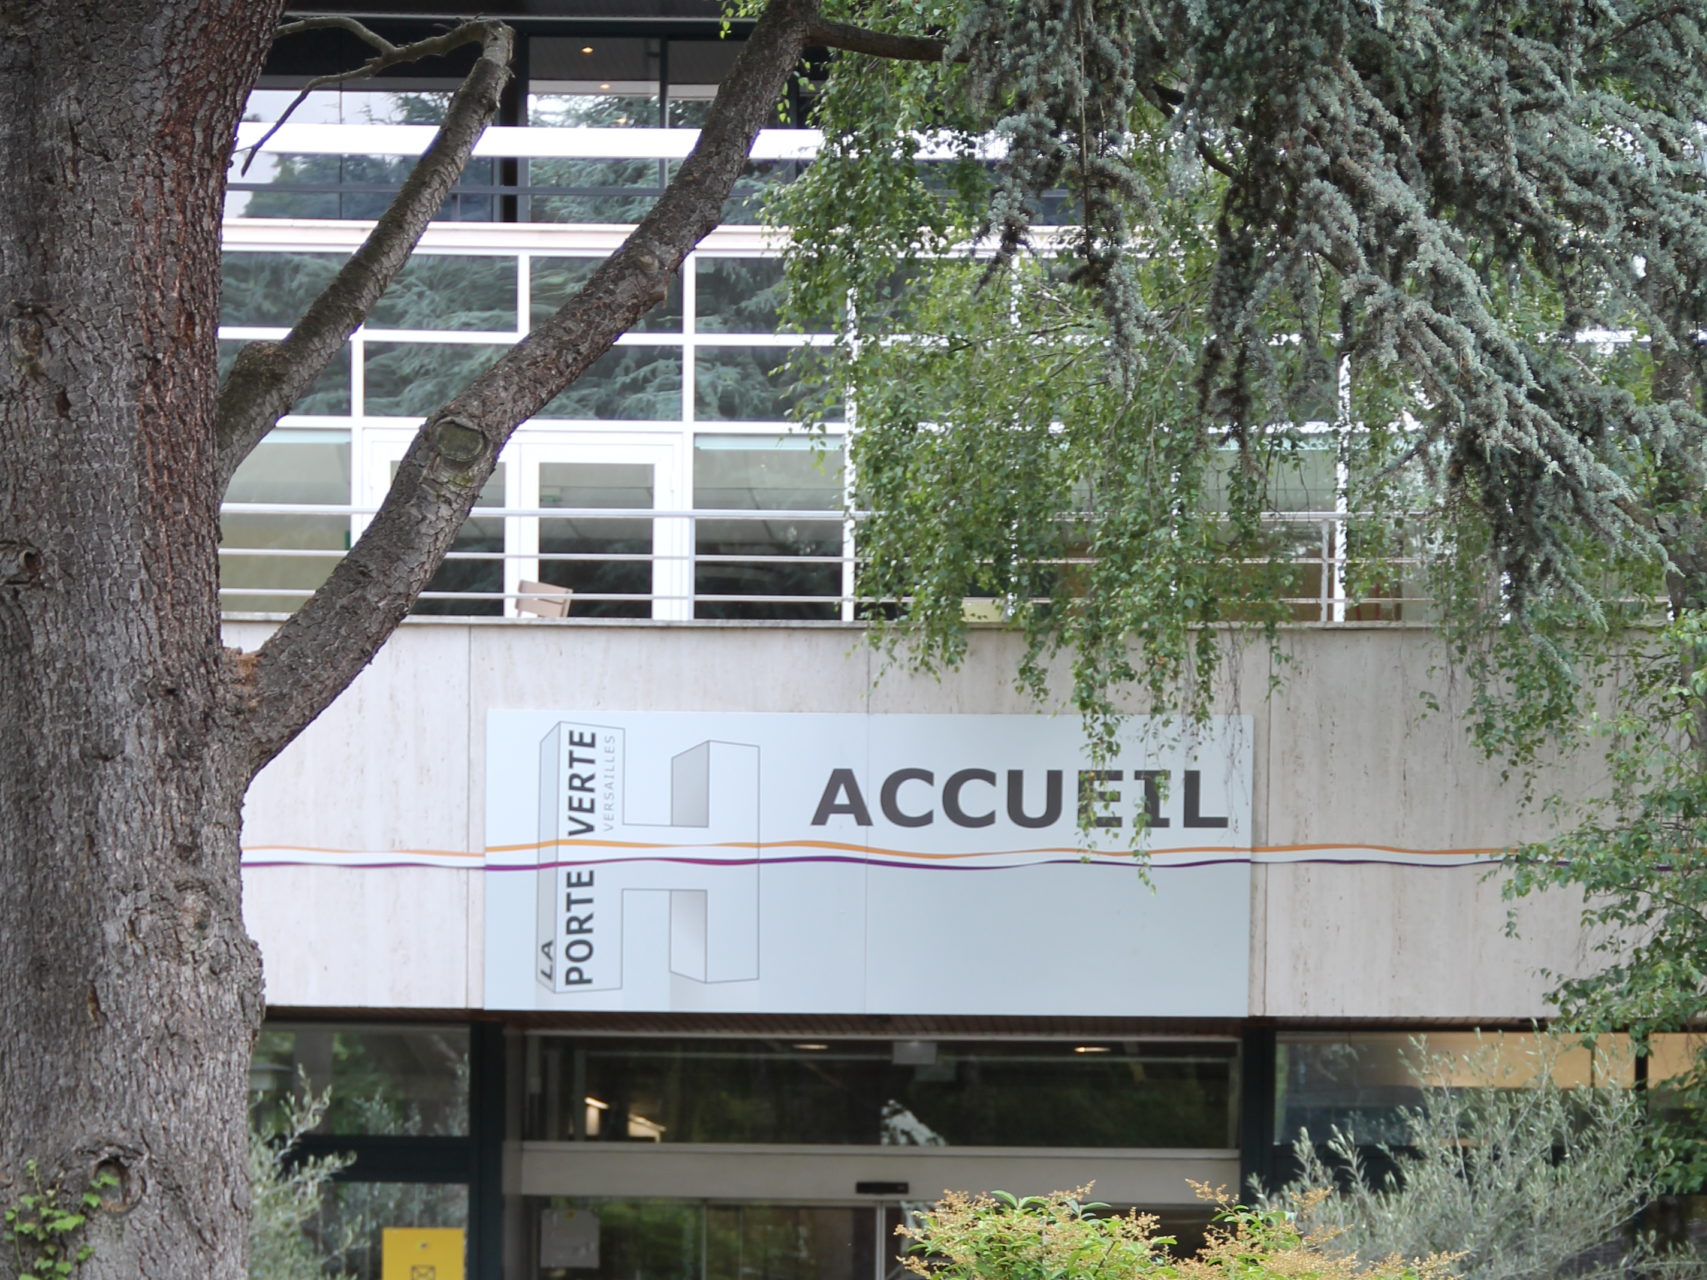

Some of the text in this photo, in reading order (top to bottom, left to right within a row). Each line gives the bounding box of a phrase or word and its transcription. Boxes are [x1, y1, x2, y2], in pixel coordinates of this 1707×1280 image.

[603, 735, 615, 832] VERSAILLES
[810, 768, 1229, 828] ACCUEIL
[565, 730, 596, 986] PORTE VERTE
[540, 939, 553, 981] LA
